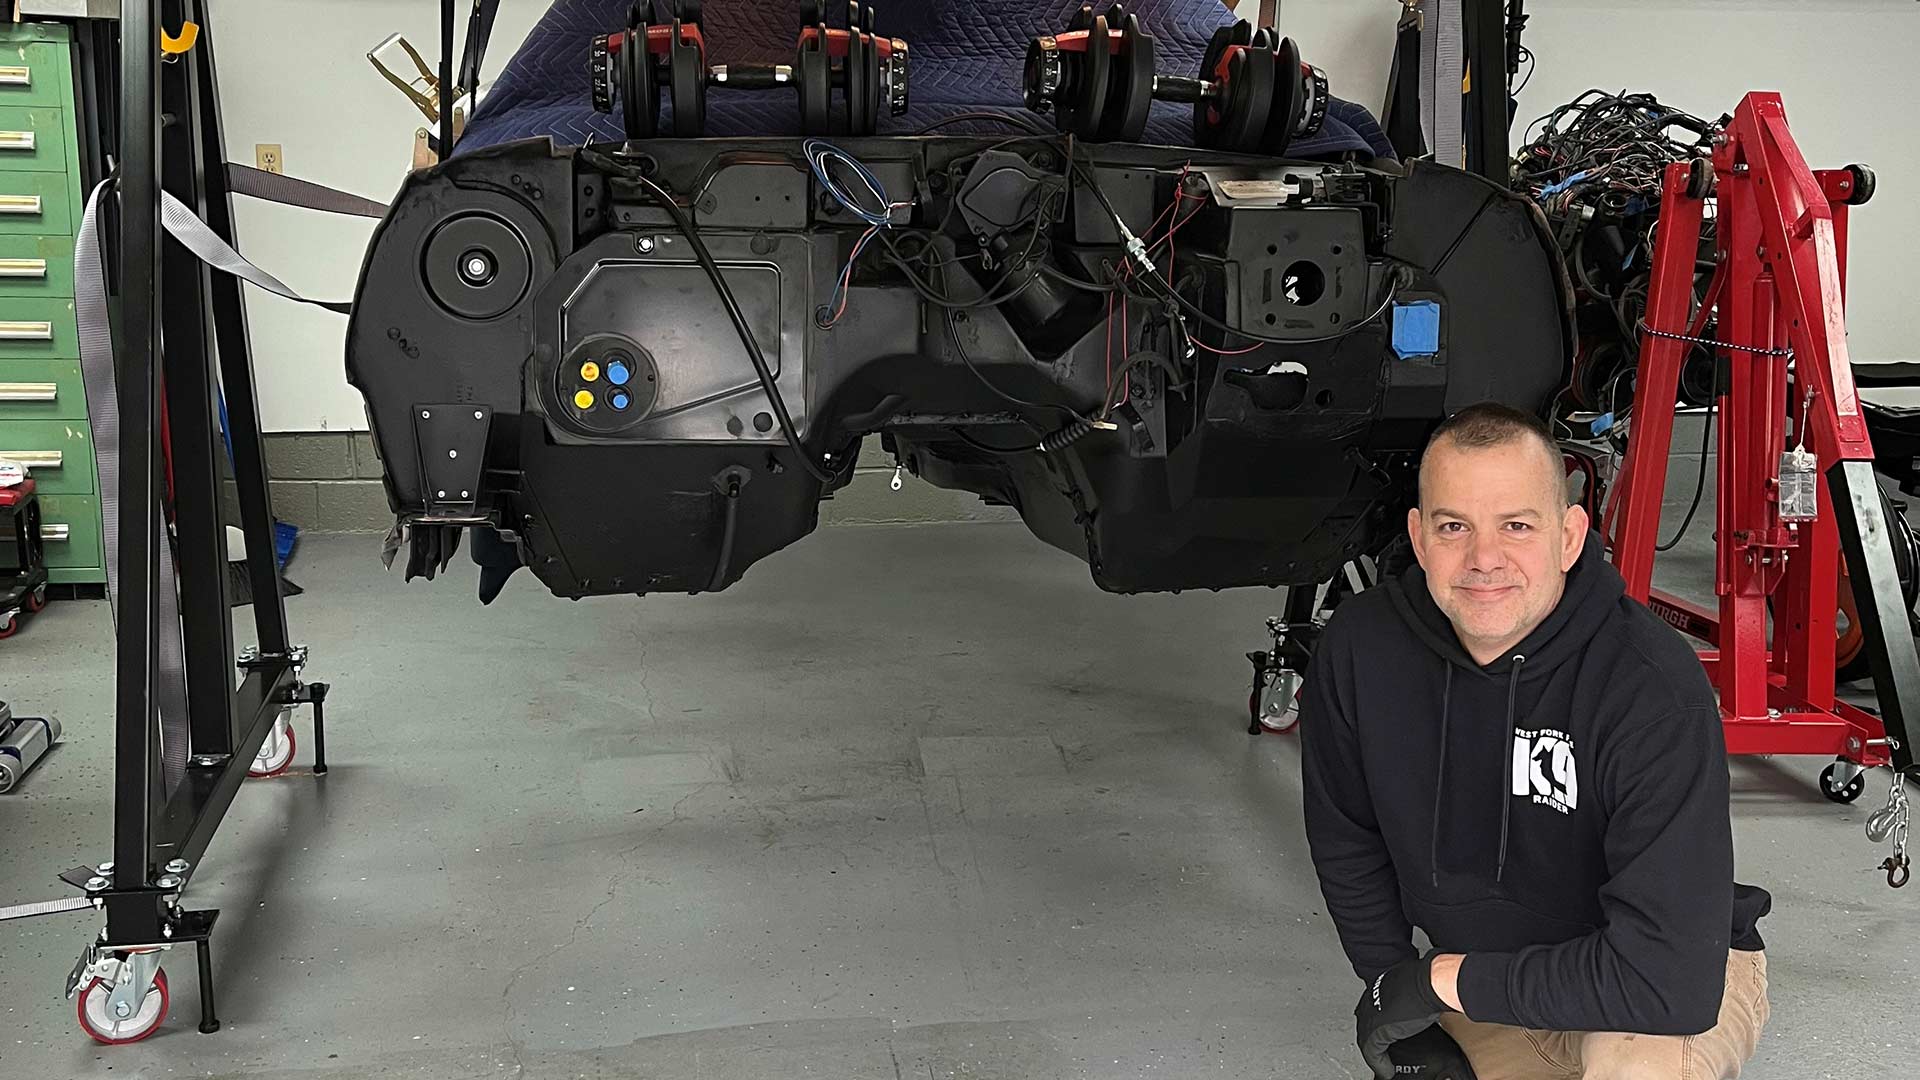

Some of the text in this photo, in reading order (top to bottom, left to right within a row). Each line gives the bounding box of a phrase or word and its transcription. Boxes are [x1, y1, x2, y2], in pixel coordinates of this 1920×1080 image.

[1540, 728, 1564, 739] FORK
[1512, 735, 1578, 810] K9
[1533, 795, 1569, 815] RAIDER
[1395, 1065, 1421, 1074] RDY
